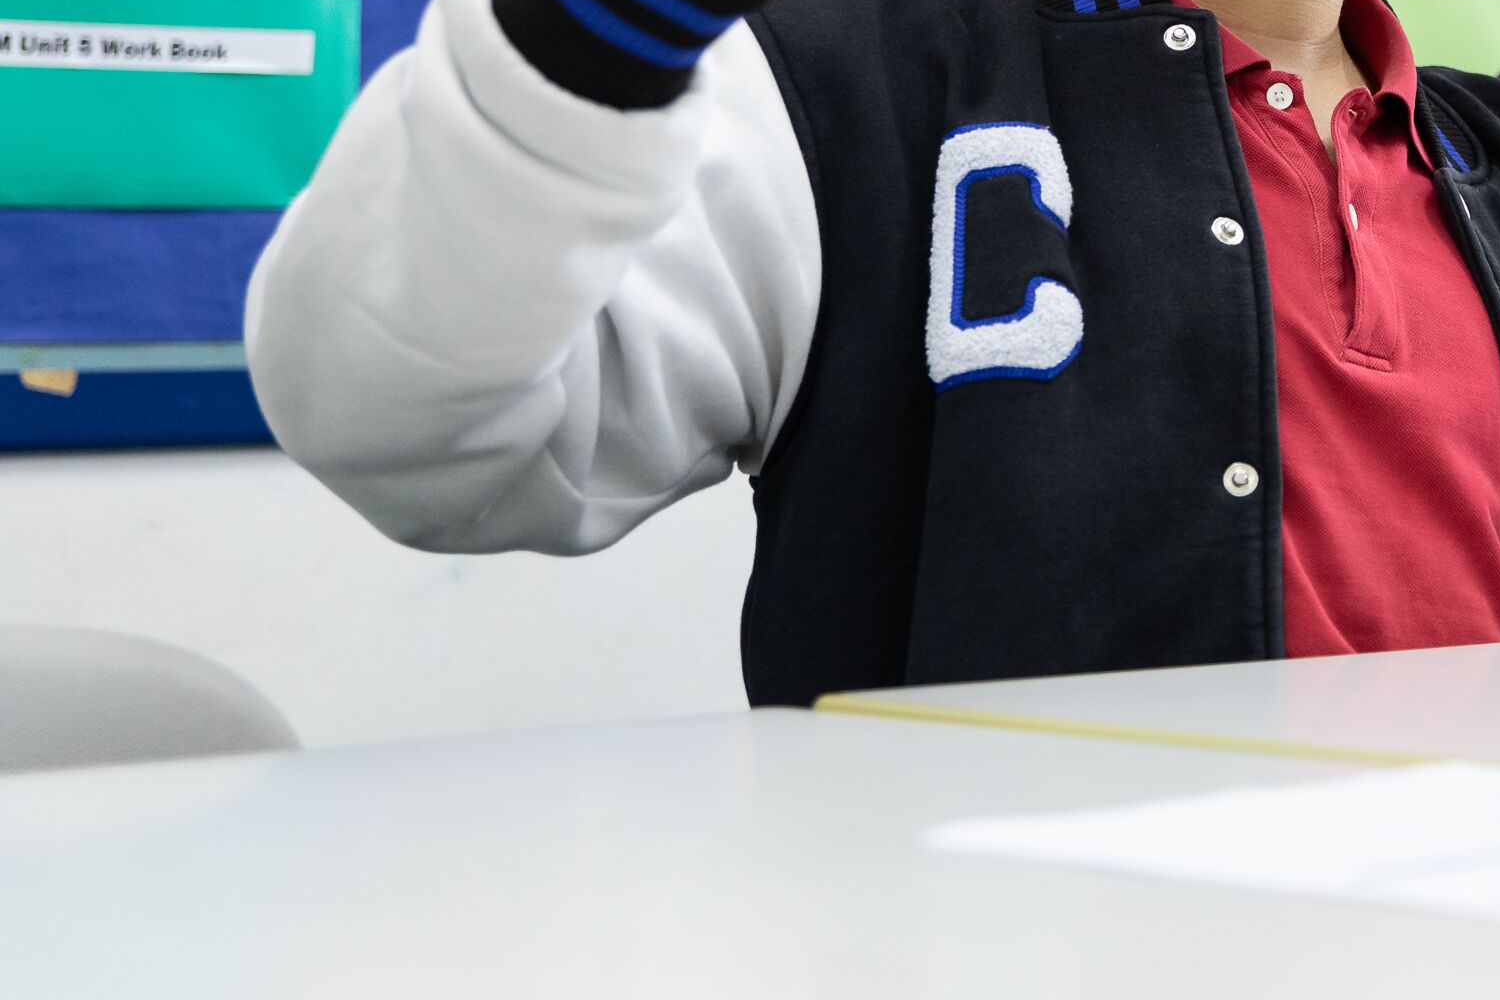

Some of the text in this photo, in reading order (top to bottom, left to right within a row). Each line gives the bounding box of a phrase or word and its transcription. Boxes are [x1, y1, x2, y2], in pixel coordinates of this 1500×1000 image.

[20, 35, 69, 55] Unit
[102, 39, 162, 60] Work
[170, 42, 228, 62] Book
[925, 121, 1084, 392] C
